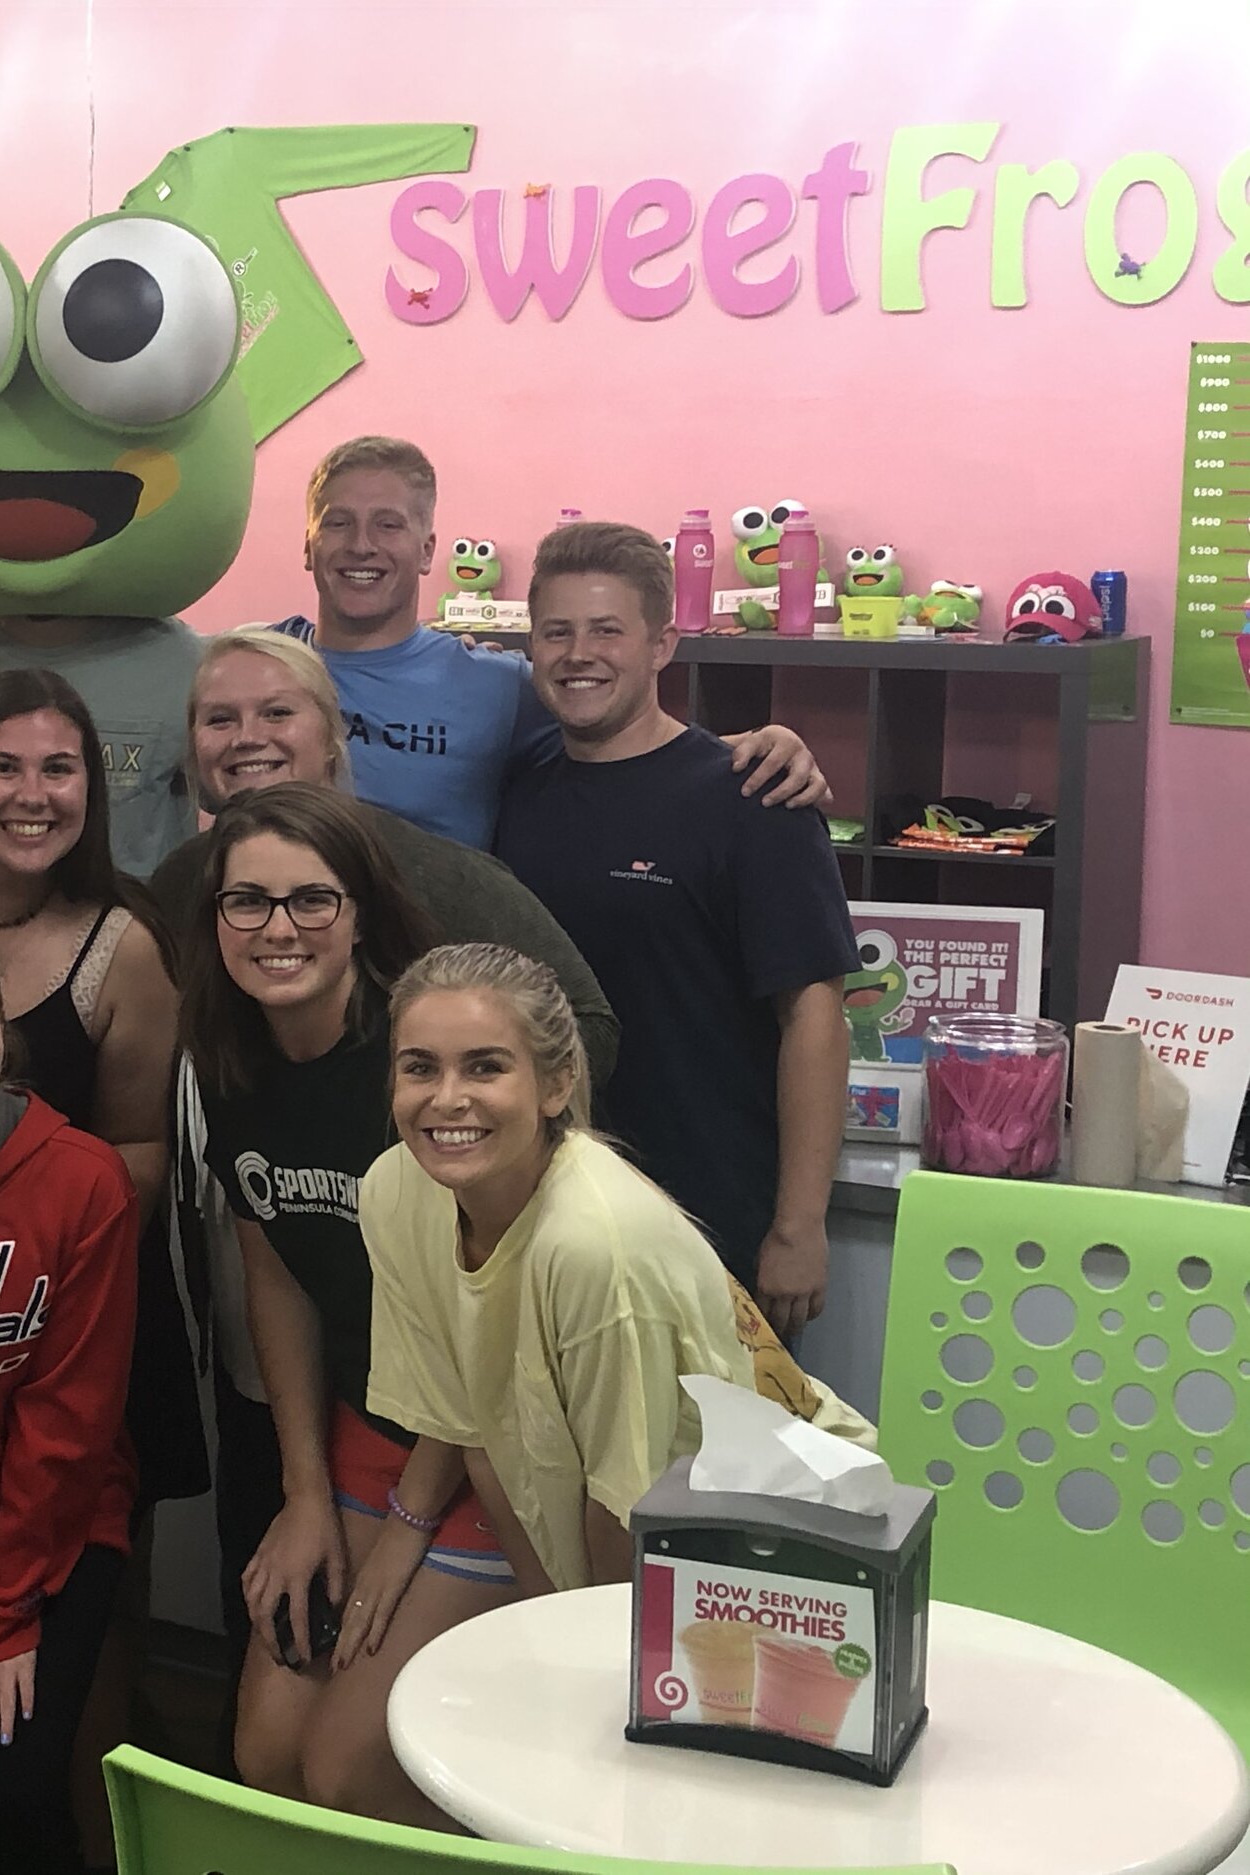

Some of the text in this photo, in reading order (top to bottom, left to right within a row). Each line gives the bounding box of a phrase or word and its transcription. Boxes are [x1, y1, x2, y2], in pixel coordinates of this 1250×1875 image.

[1196, 354, 1231, 364] $1000
[1200, 377, 1230, 387] $900
[1198, 402, 1228, 413] $800
[1197, 430, 1227, 440] $700
[1195, 459, 1225, 469] $600
[1193, 487, 1223, 497] $500
[1191, 517, 1221, 527] $400
[1188, 575, 1218, 584] $200
[1188, 603, 1216, 612] $100
[383, 723, 446, 755] CHI
[609, 869, 673, 885] vineyard vines
[905, 939, 1009, 954] YOU FOUND IT!
[904, 951, 1008, 967] THE PERFECT
[906, 965, 1007, 1001] GIFT
[935, 1000, 943, 1008] A
[945, 1000, 969, 1010] GIFT
[971, 1002, 1000, 1011] CARD
[1166, 991, 1235, 1007] DOORDASH
[1198, 1026, 1235, 1046] UP
[1150, 1045, 1210, 1068] ERE
[279, 1201, 334, 1214] PENINSULA
[696, 1579, 848, 1619] NOW SERVING
[694, 1598, 846, 1642] SMOOTHIES
